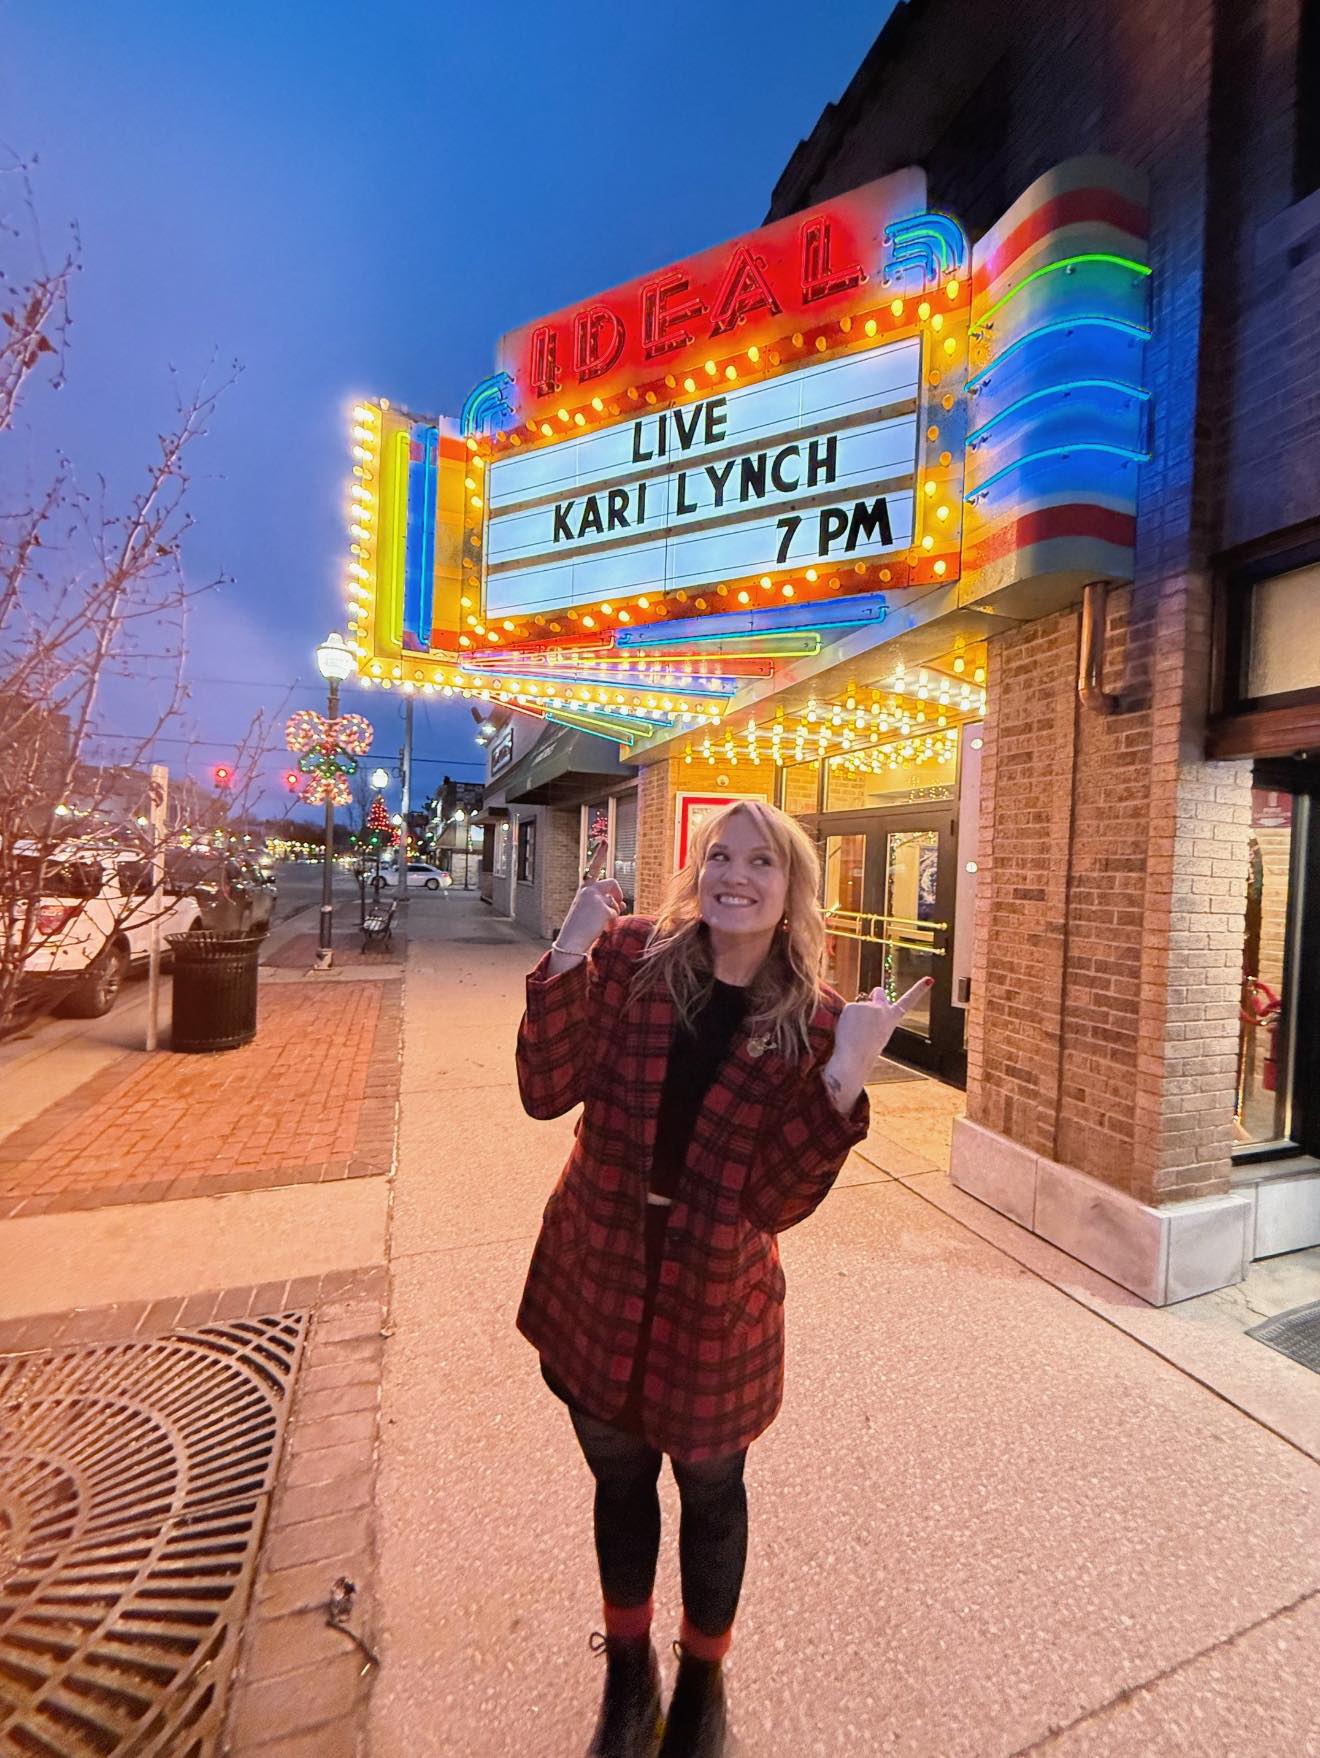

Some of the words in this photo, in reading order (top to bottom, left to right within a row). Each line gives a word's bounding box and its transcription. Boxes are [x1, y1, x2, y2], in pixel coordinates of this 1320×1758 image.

[531, 214, 864, 398] IDEAL
[632, 396, 728, 464] LIVE
[553, 482, 647, 543] KARI
[676, 435, 838, 516] LYNCH
[776, 514, 802, 564] 7
[818, 496, 893, 557] PM
